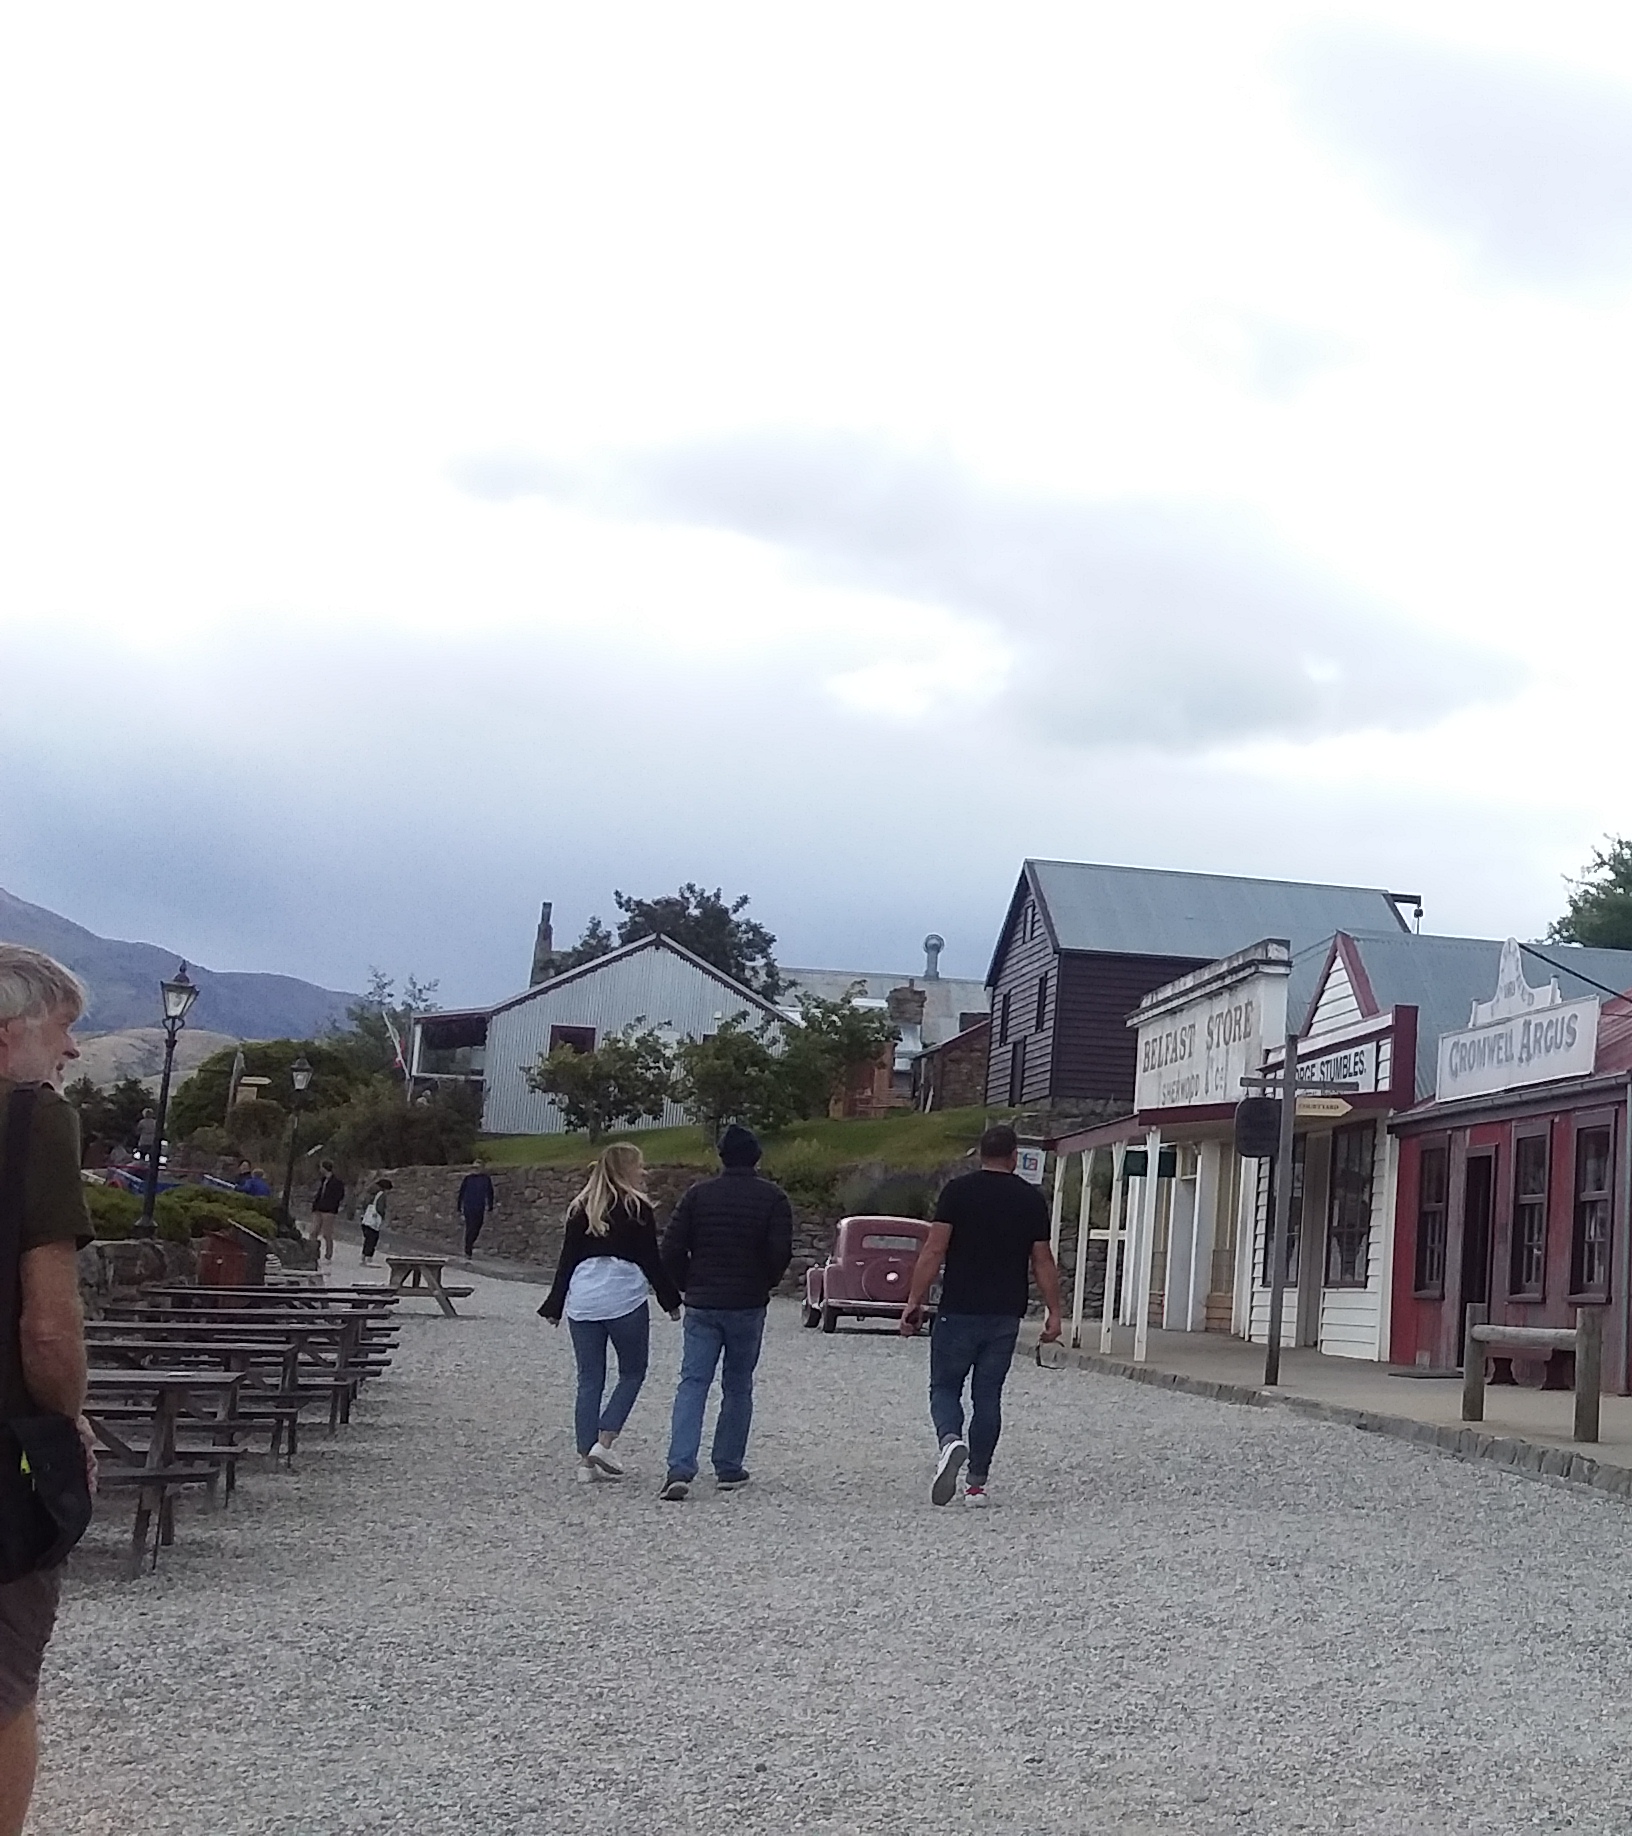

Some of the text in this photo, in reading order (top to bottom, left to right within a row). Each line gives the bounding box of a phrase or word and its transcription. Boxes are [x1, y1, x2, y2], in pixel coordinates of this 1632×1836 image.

[1143, 1000, 1254, 1073] BELFAST STORE
[1449, 1012, 1579, 1080] CROMWELL ARGUS
